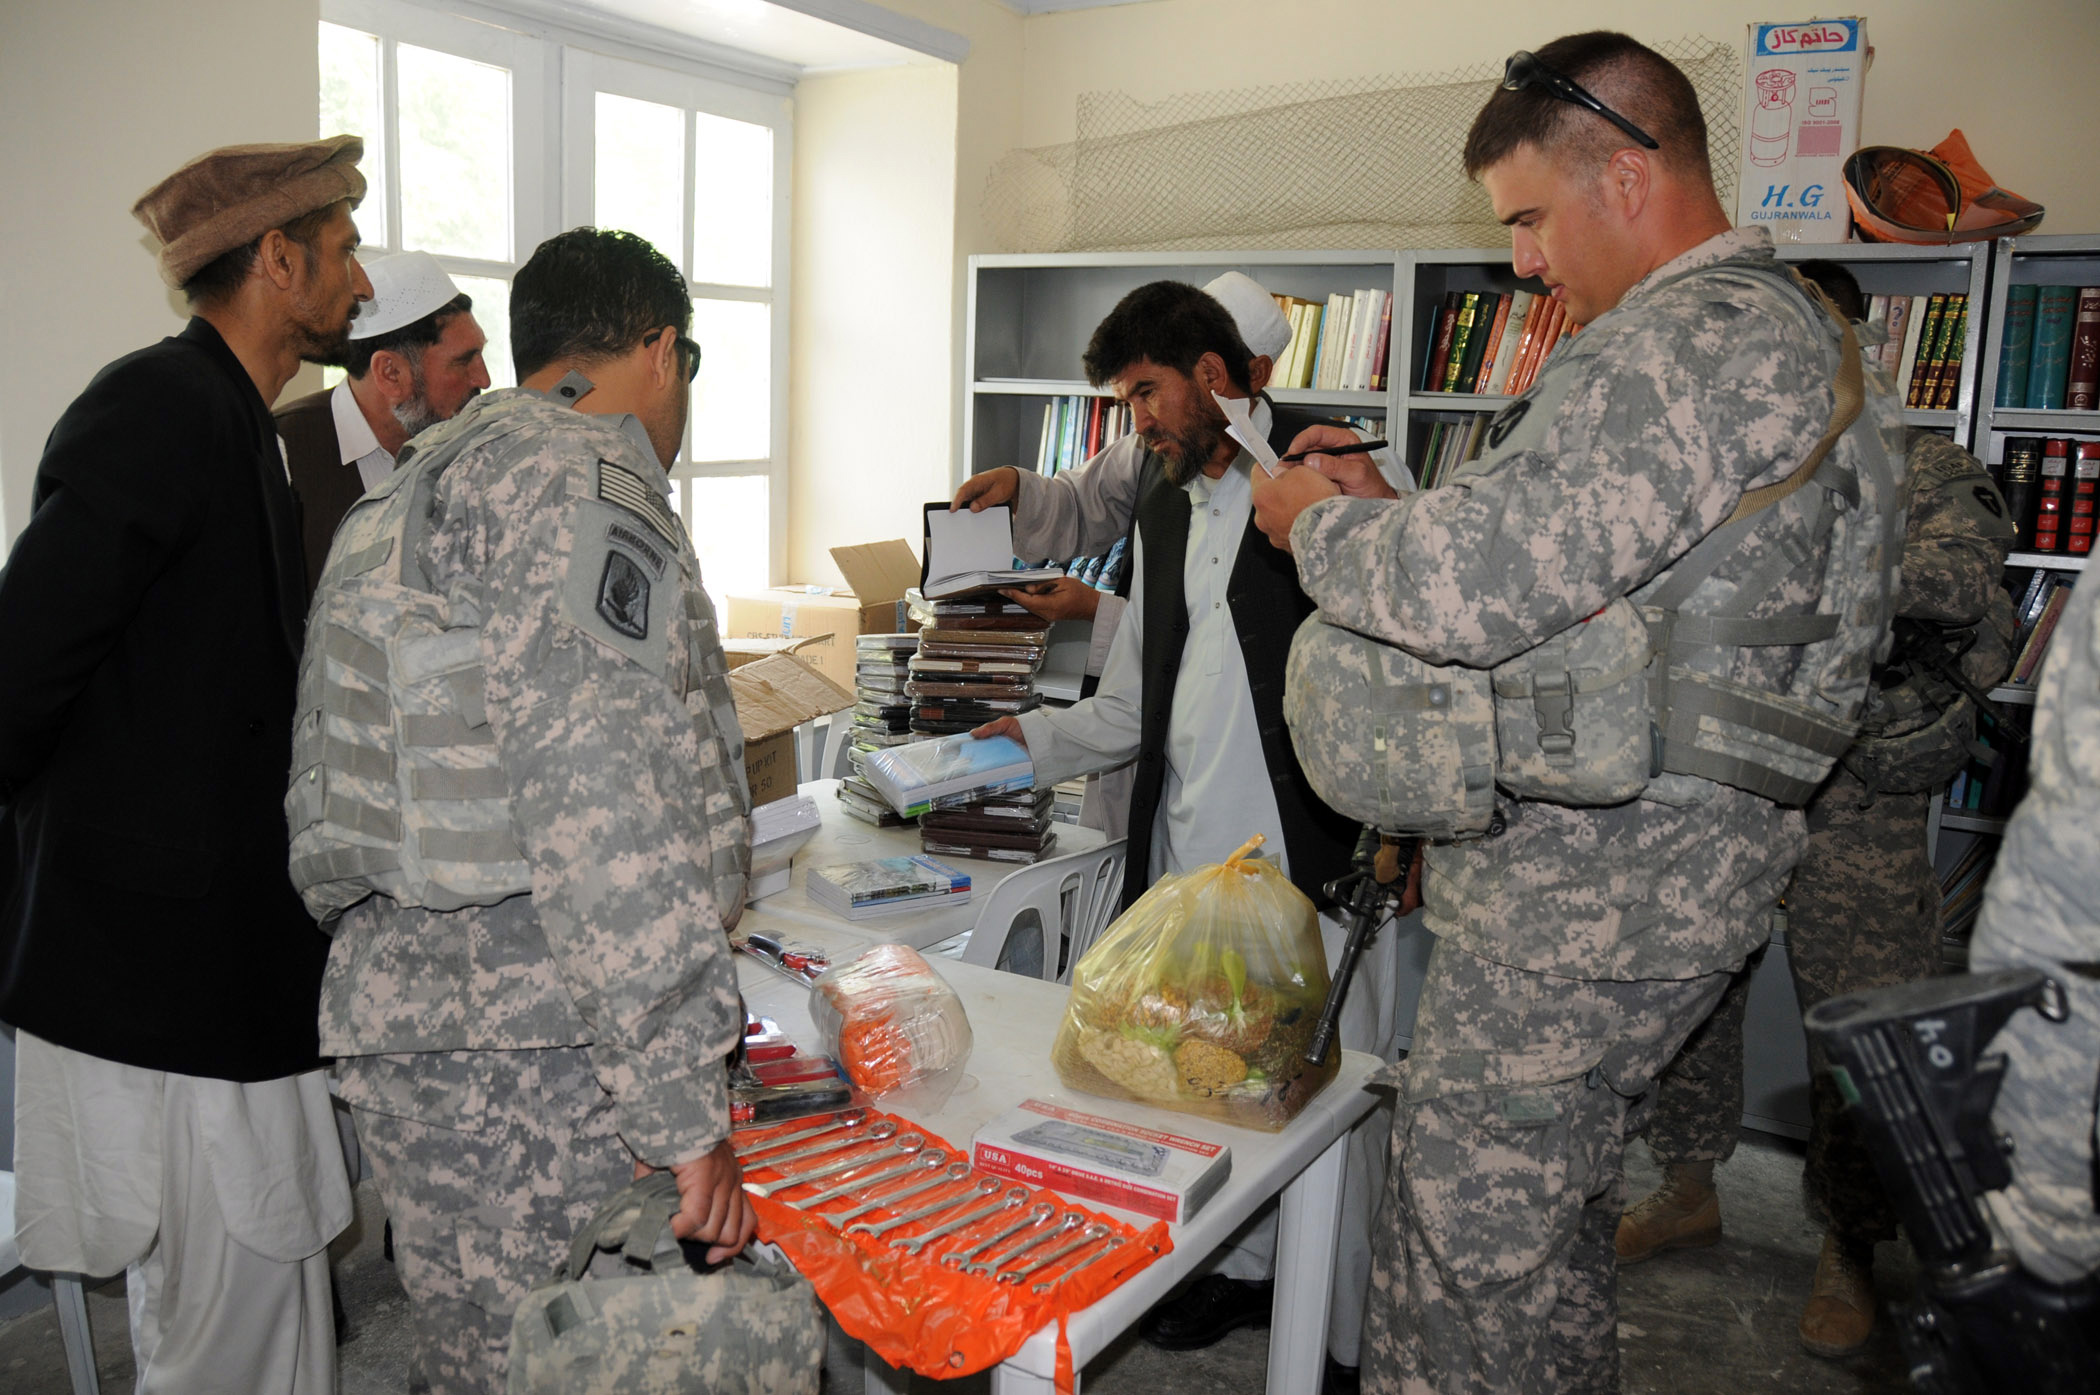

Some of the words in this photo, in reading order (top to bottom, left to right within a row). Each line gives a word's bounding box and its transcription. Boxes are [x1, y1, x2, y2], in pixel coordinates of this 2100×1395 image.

[1750, 211, 1832, 220] GUJRANWALA
[610, 526, 664, 569] AIRBORNE
[984, 1150, 1007, 1164] USA
[1014, 1163, 1043, 1179] 40pcs
